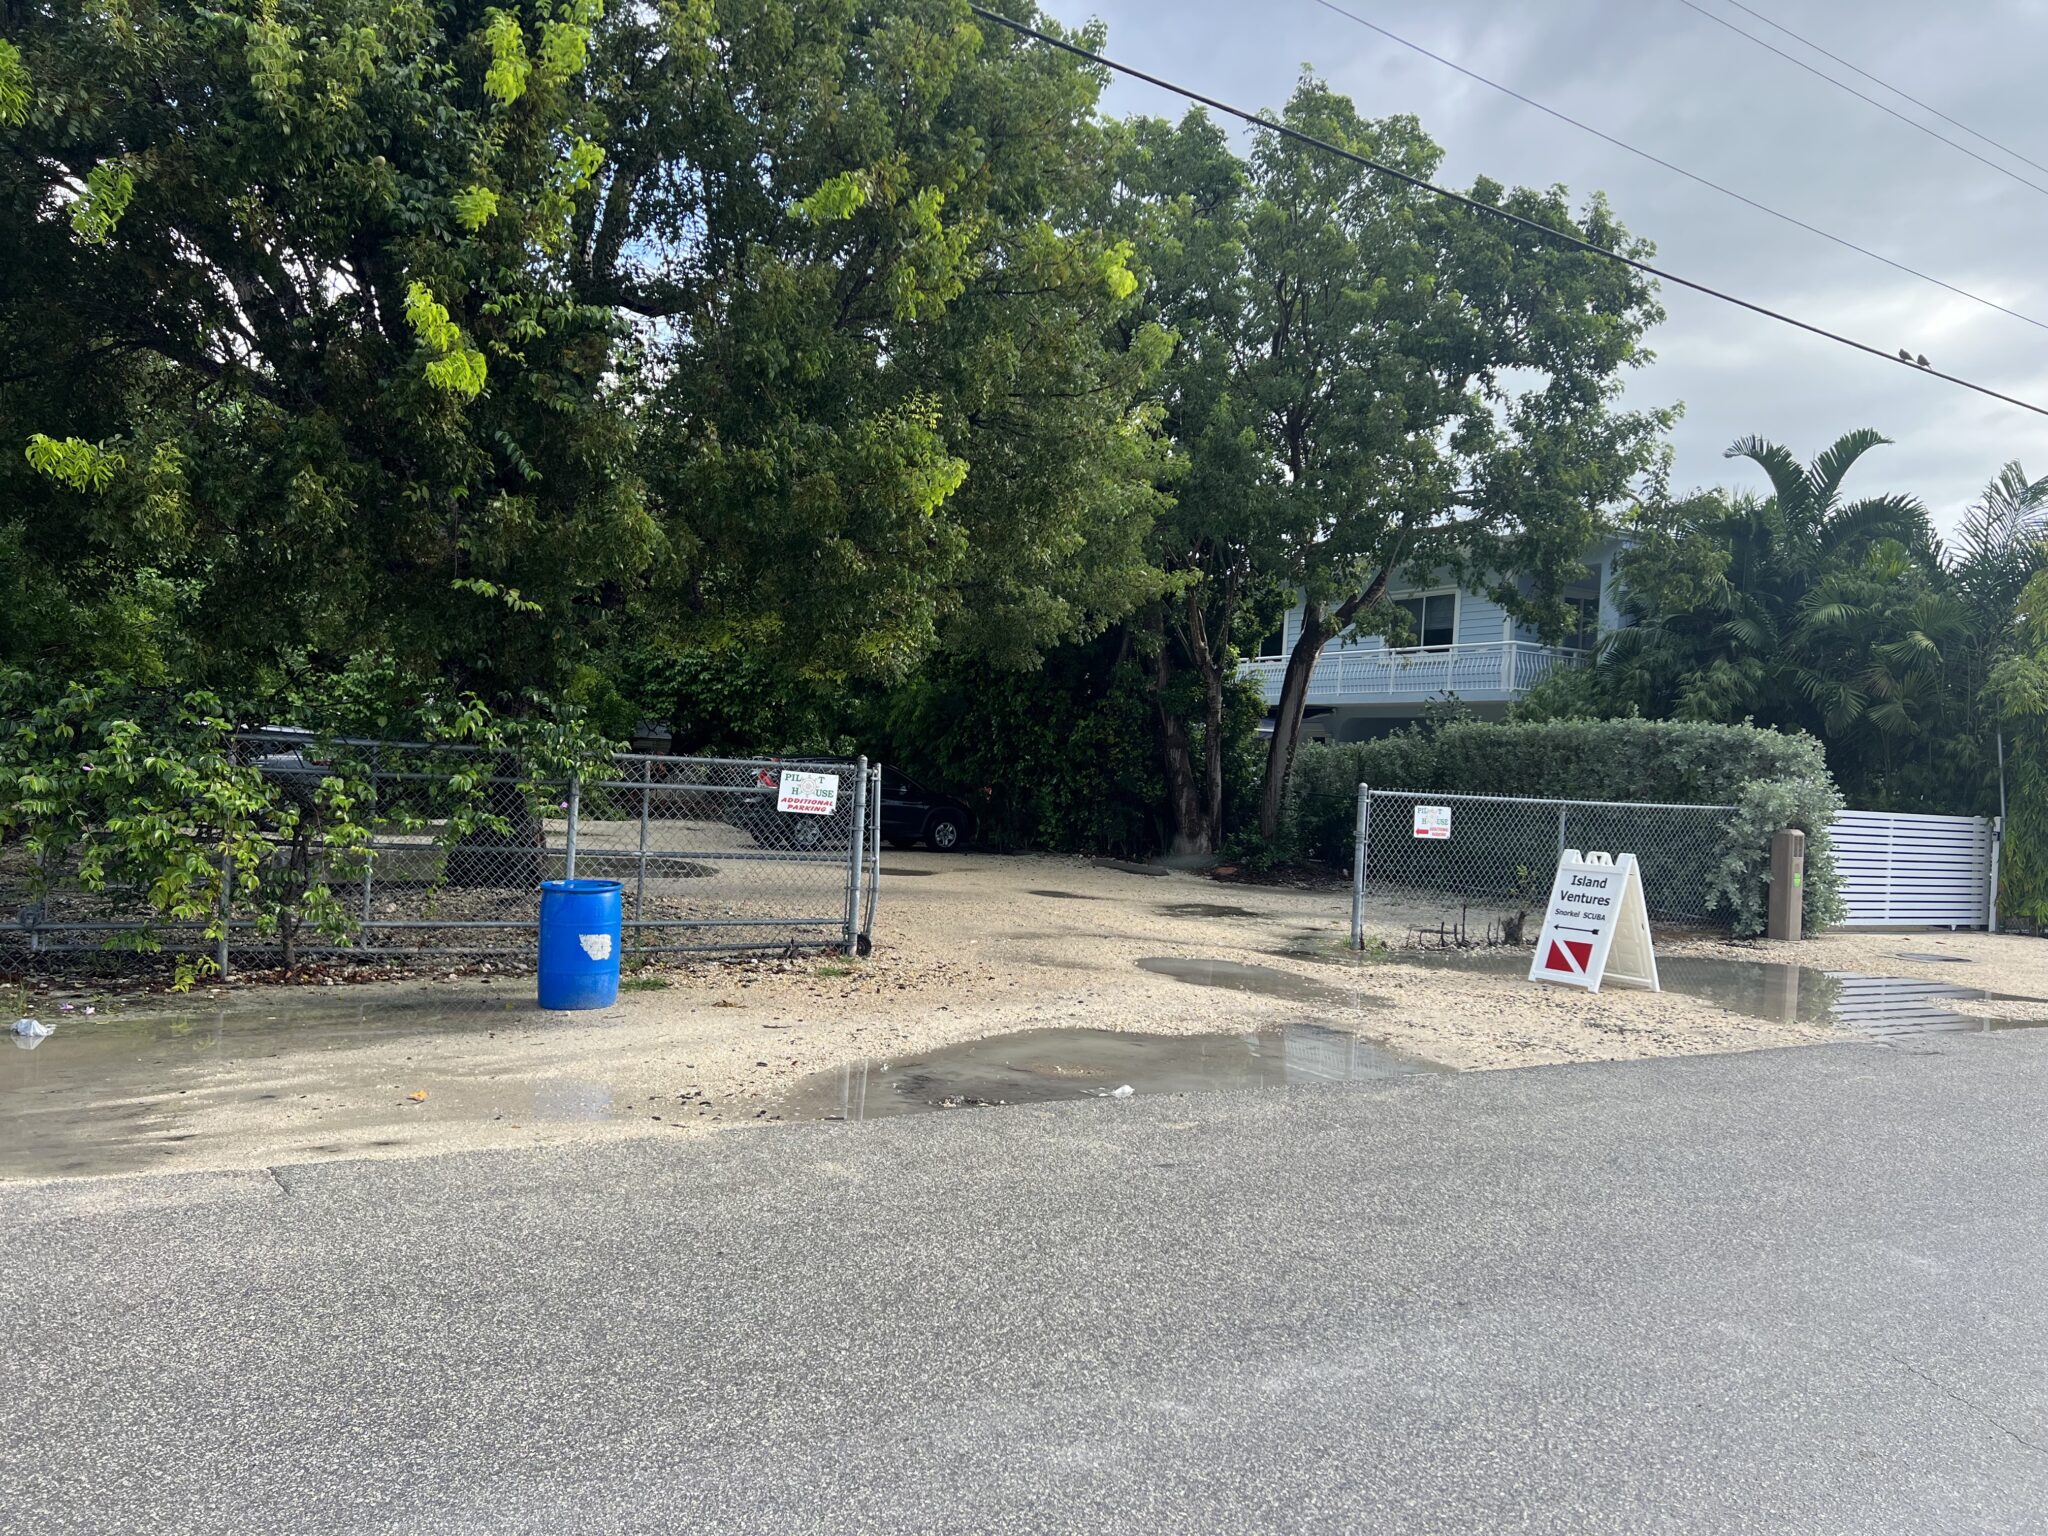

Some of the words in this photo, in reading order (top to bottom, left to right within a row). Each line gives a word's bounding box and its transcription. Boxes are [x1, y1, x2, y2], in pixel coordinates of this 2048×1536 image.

[781, 797, 833, 806] ADDITIONAL
[787, 804, 827, 812] PARKING
[1571, 875, 1608, 889] Island
[1560, 890, 1611, 906] Ventures
[1554, 908, 1580, 918] Snorkel
[1583, 912, 1606, 921] SCUBA
